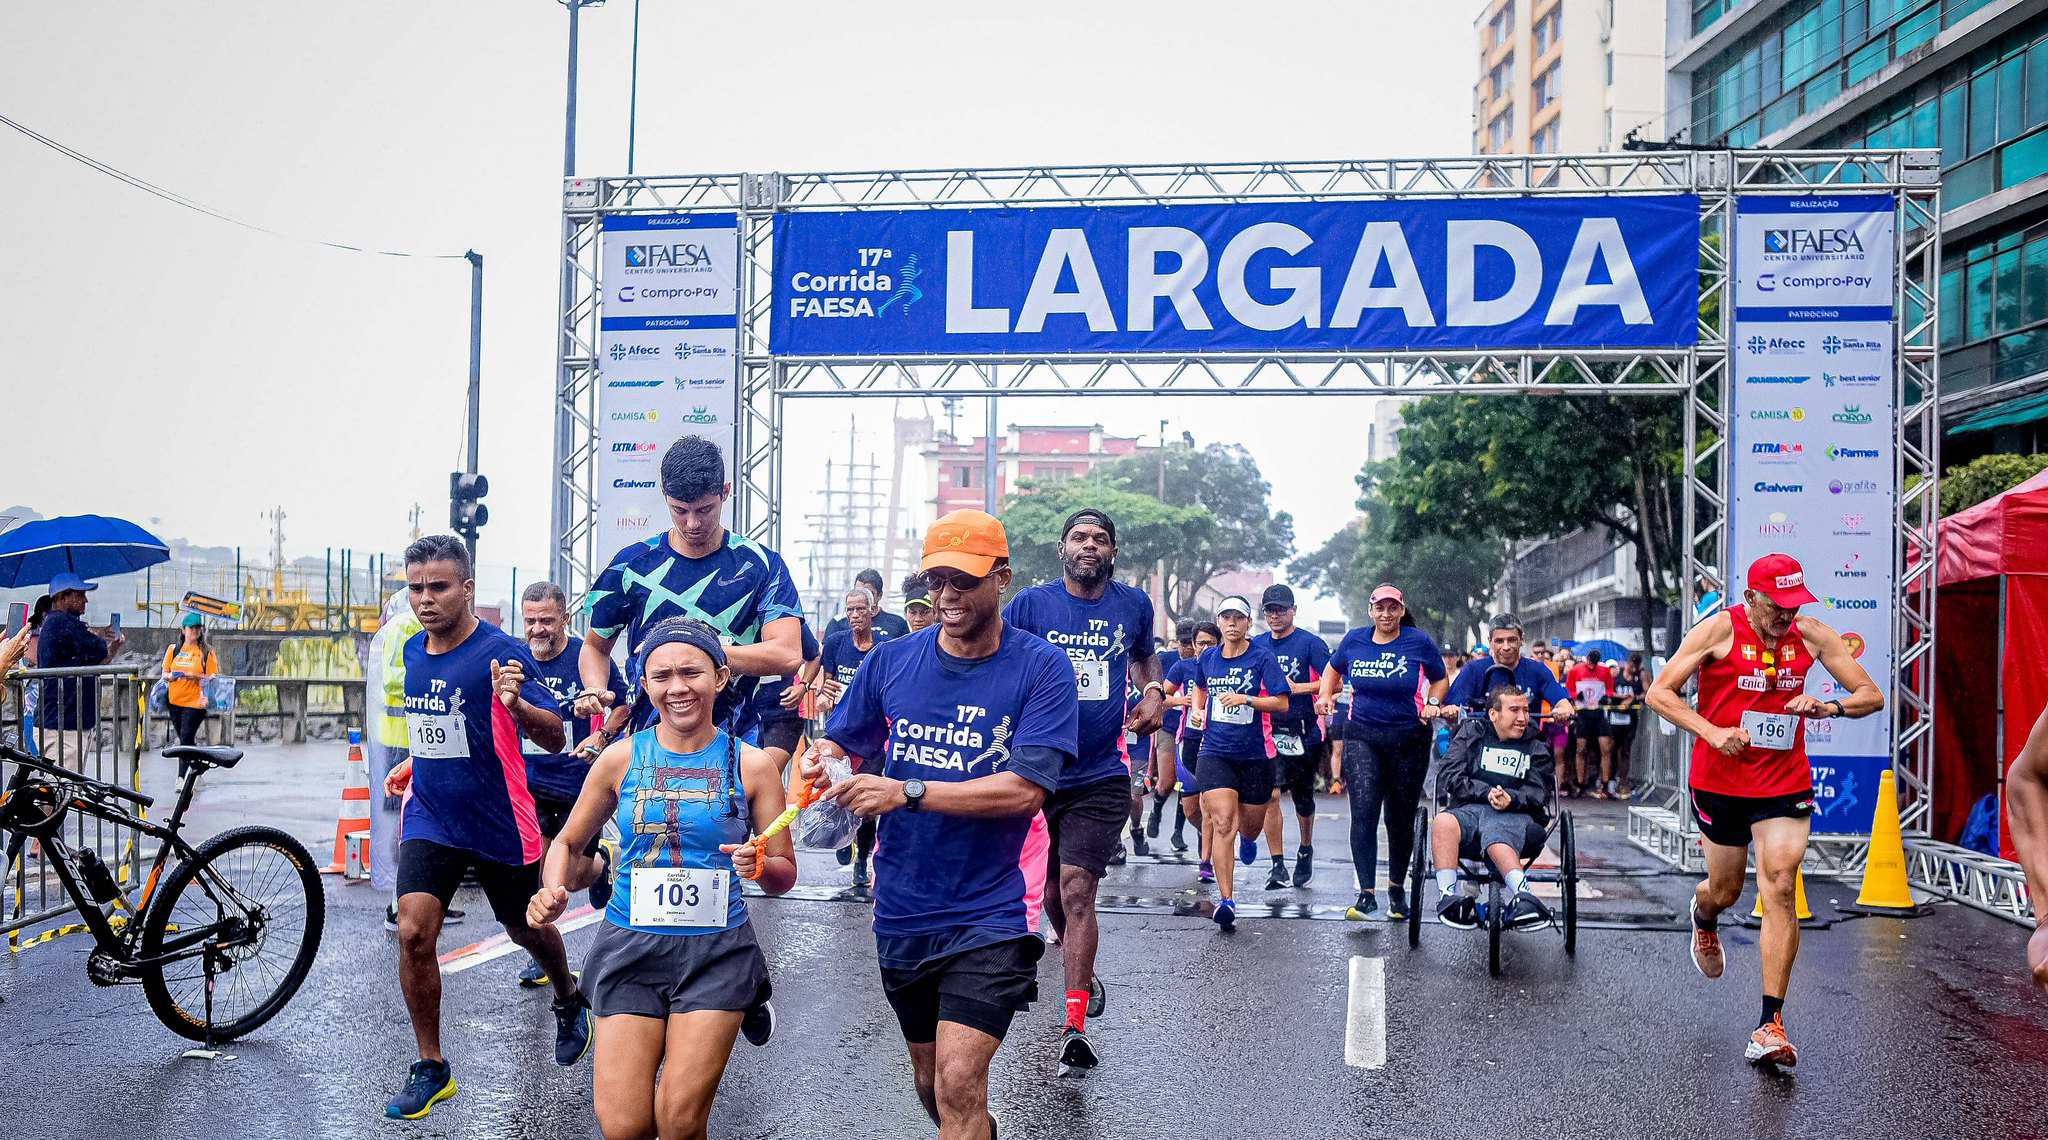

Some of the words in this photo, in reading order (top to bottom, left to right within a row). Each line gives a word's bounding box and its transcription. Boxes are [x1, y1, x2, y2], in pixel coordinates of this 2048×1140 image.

[1791, 229, 1864, 253] FAESA
[649, 244, 712, 267] FAESA
[858, 248, 892, 267] 17ª
[791, 269, 892, 292] Corrida
[944, 216, 1654, 334] LARGADA
[790, 297, 875, 318] FAESA
[1788, 310, 1840, 318] PATROCÍNIO
[645, 318, 690, 327] PATROCÍNIO
[628, 344, 661, 355] Afecc
[1769, 338, 1806, 348] Afecc
[704, 377, 726, 385] senior
[1839, 374, 1856, 382] best
[611, 412, 646, 421] CAMISA
[682, 414, 718, 423] COROA
[1750, 410, 1790, 420] CAMISA
[1831, 413, 1873, 422] COROA
[611, 442, 657, 452] EXTRABOM
[616, 516, 650, 527] HINTZ
[1758, 523, 1797, 534] HINTZ
[933, 529, 973, 550] Sol
[1836, 599, 1877, 610] SICOOB
[1088, 618, 1109, 631] 17ª
[1046, 629, 1109, 647] Corrida
[1065, 647, 1098, 661] ESA
[1352, 659, 1394, 669] Corrida
[1350, 668, 1386, 678] FAESA
[1206, 675, 1242, 686] Corrida
[403, 692, 446, 713] orrida
[956, 704, 987, 724] 17ª
[417, 726, 446, 744] 189
[895, 718, 984, 749] Corrida
[1756, 722, 1785, 738] 196
[892, 741, 965, 772] FAESA
[1496, 755, 1517, 768] 192
[654, 883, 700, 907] 103
